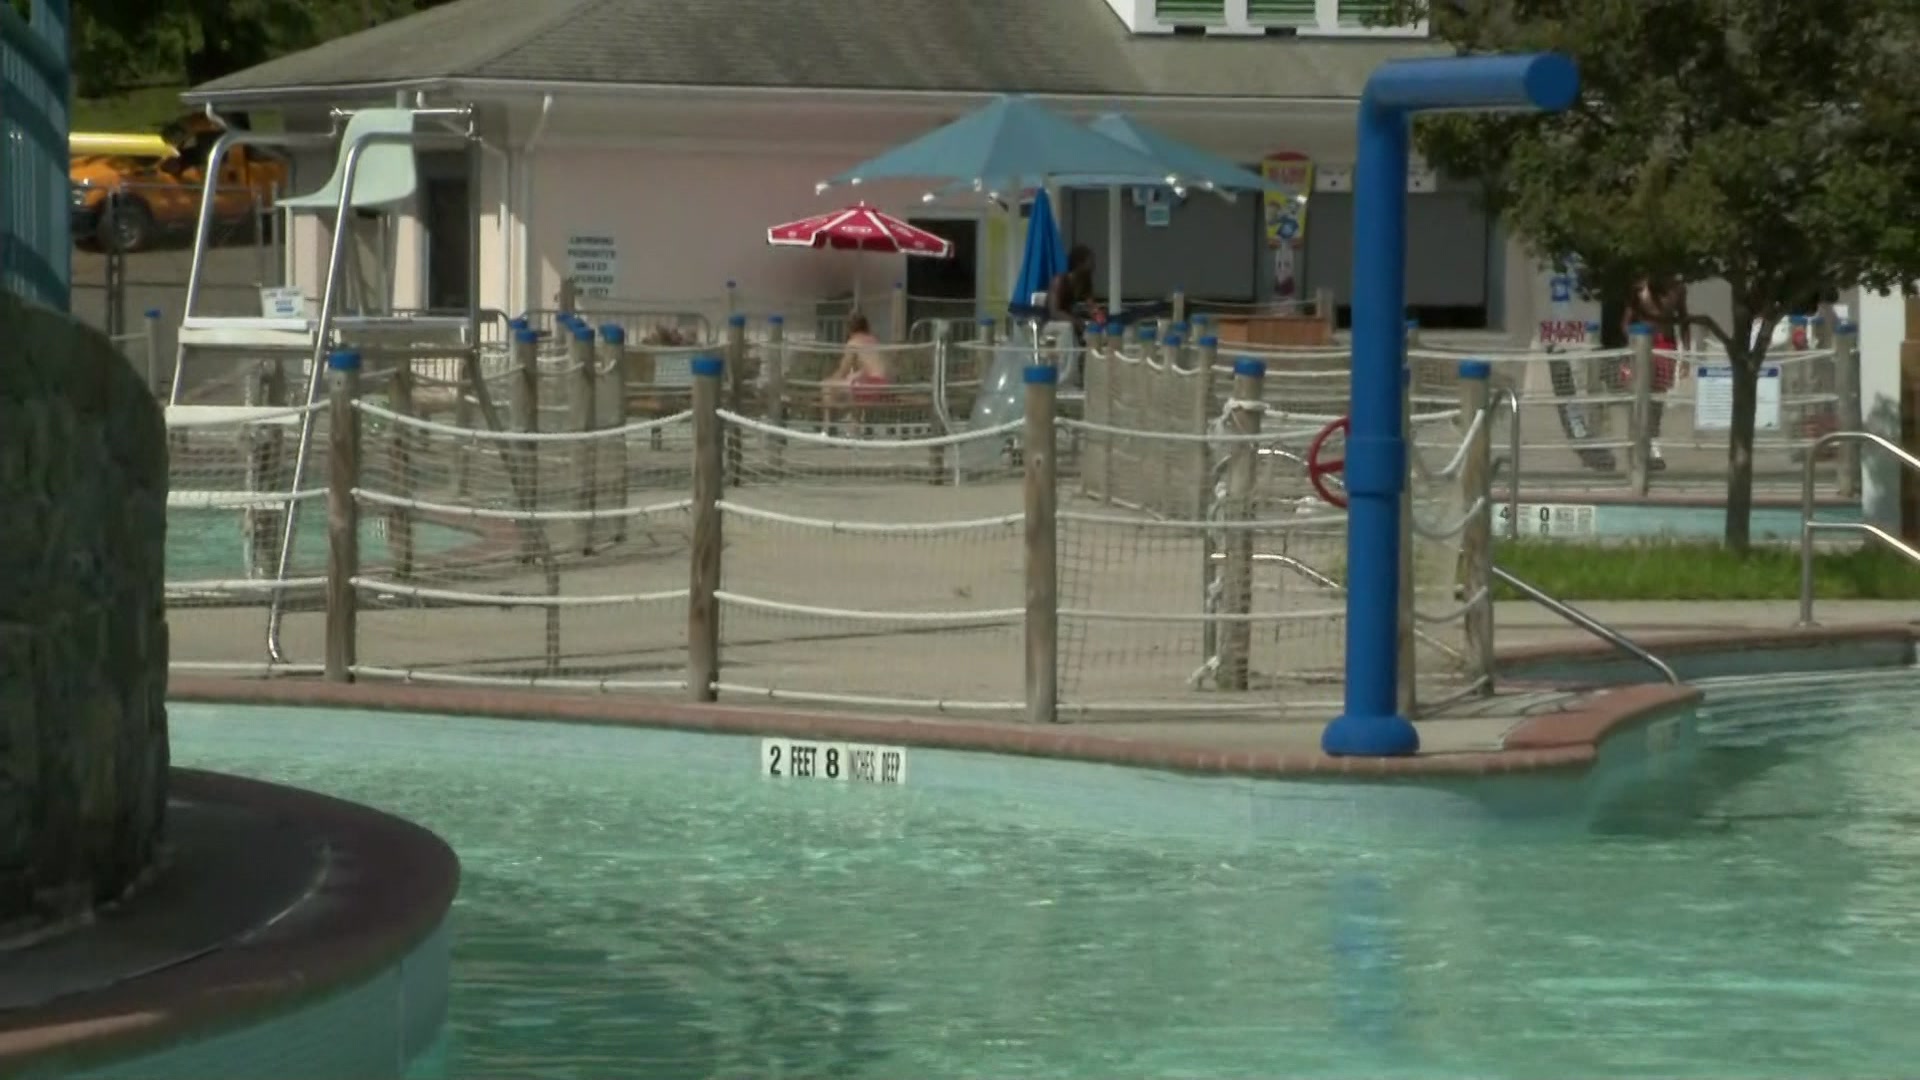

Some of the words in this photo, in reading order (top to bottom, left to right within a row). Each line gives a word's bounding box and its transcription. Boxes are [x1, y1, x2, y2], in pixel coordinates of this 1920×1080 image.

[770, 745, 782, 775] 2
[791, 746, 817, 777] FEET
[826, 748, 839, 778] 8
[881, 751, 901, 782] DEEP
